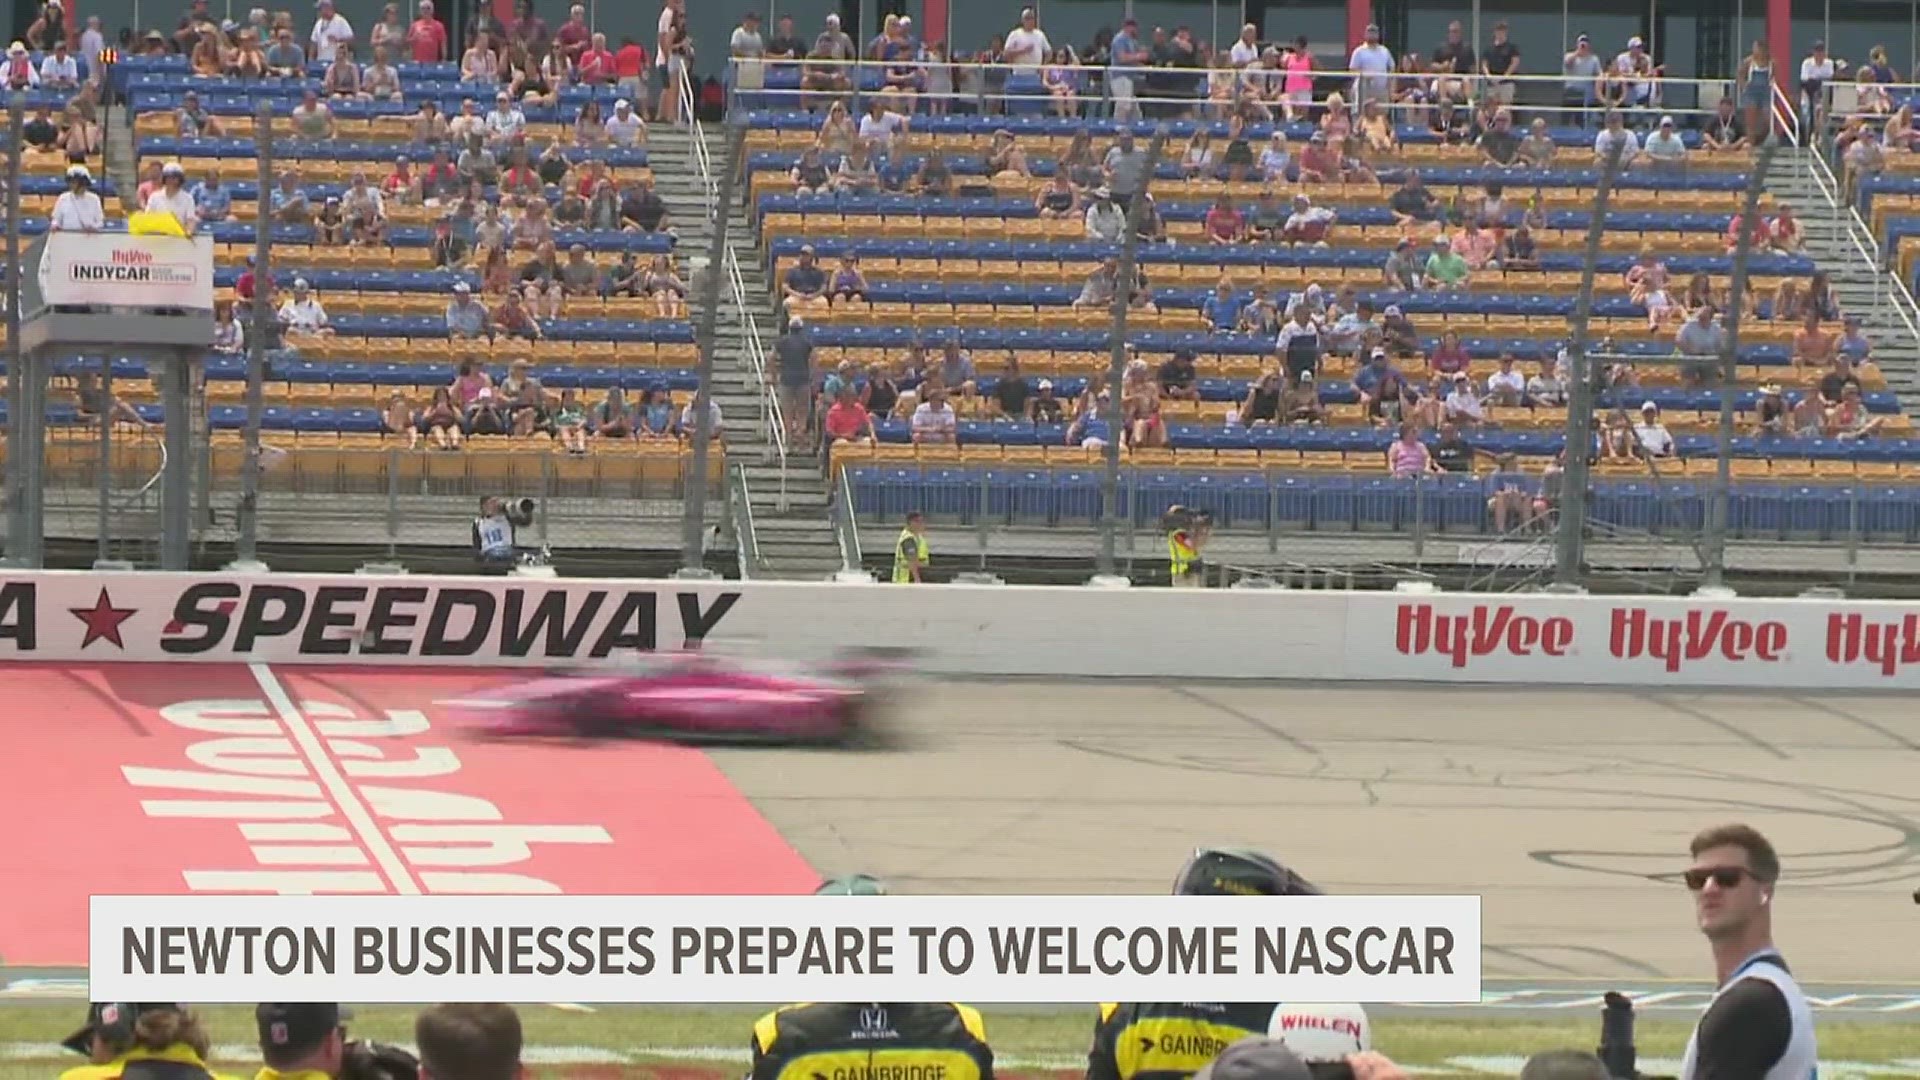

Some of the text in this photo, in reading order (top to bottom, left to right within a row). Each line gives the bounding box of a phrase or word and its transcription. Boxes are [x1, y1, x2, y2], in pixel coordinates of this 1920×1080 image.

[74, 264, 150, 281] INDYCAR
[160, 582, 742, 658] SPEEDWAY
[1395, 604, 1574, 668] HyVee
[1608, 607, 1787, 672] HyVee
[1160, 1033, 1229, 1057] GAINBR
[1281, 1014, 1361, 1037] WHELEN
